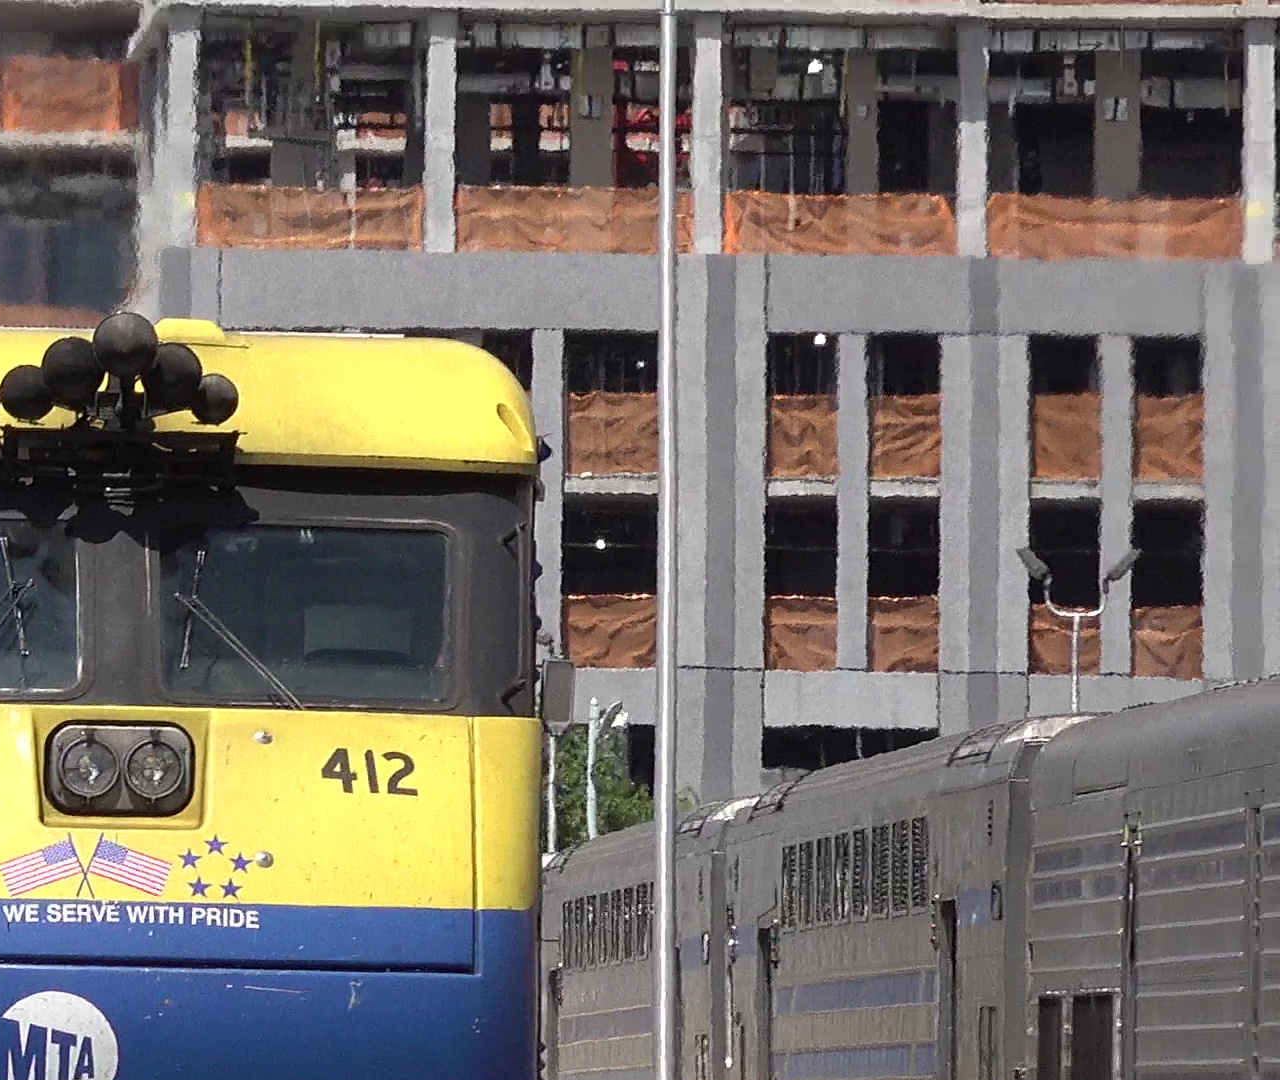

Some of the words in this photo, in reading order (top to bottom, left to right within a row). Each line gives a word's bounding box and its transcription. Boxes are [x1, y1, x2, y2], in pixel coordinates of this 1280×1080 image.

[321, 747, 419, 797] 412
[2, 903, 39, 923] WE
[46, 903, 120, 923] SERVE
[126, 905, 185, 925] WITH
[191, 907, 261, 929] PRIDE
